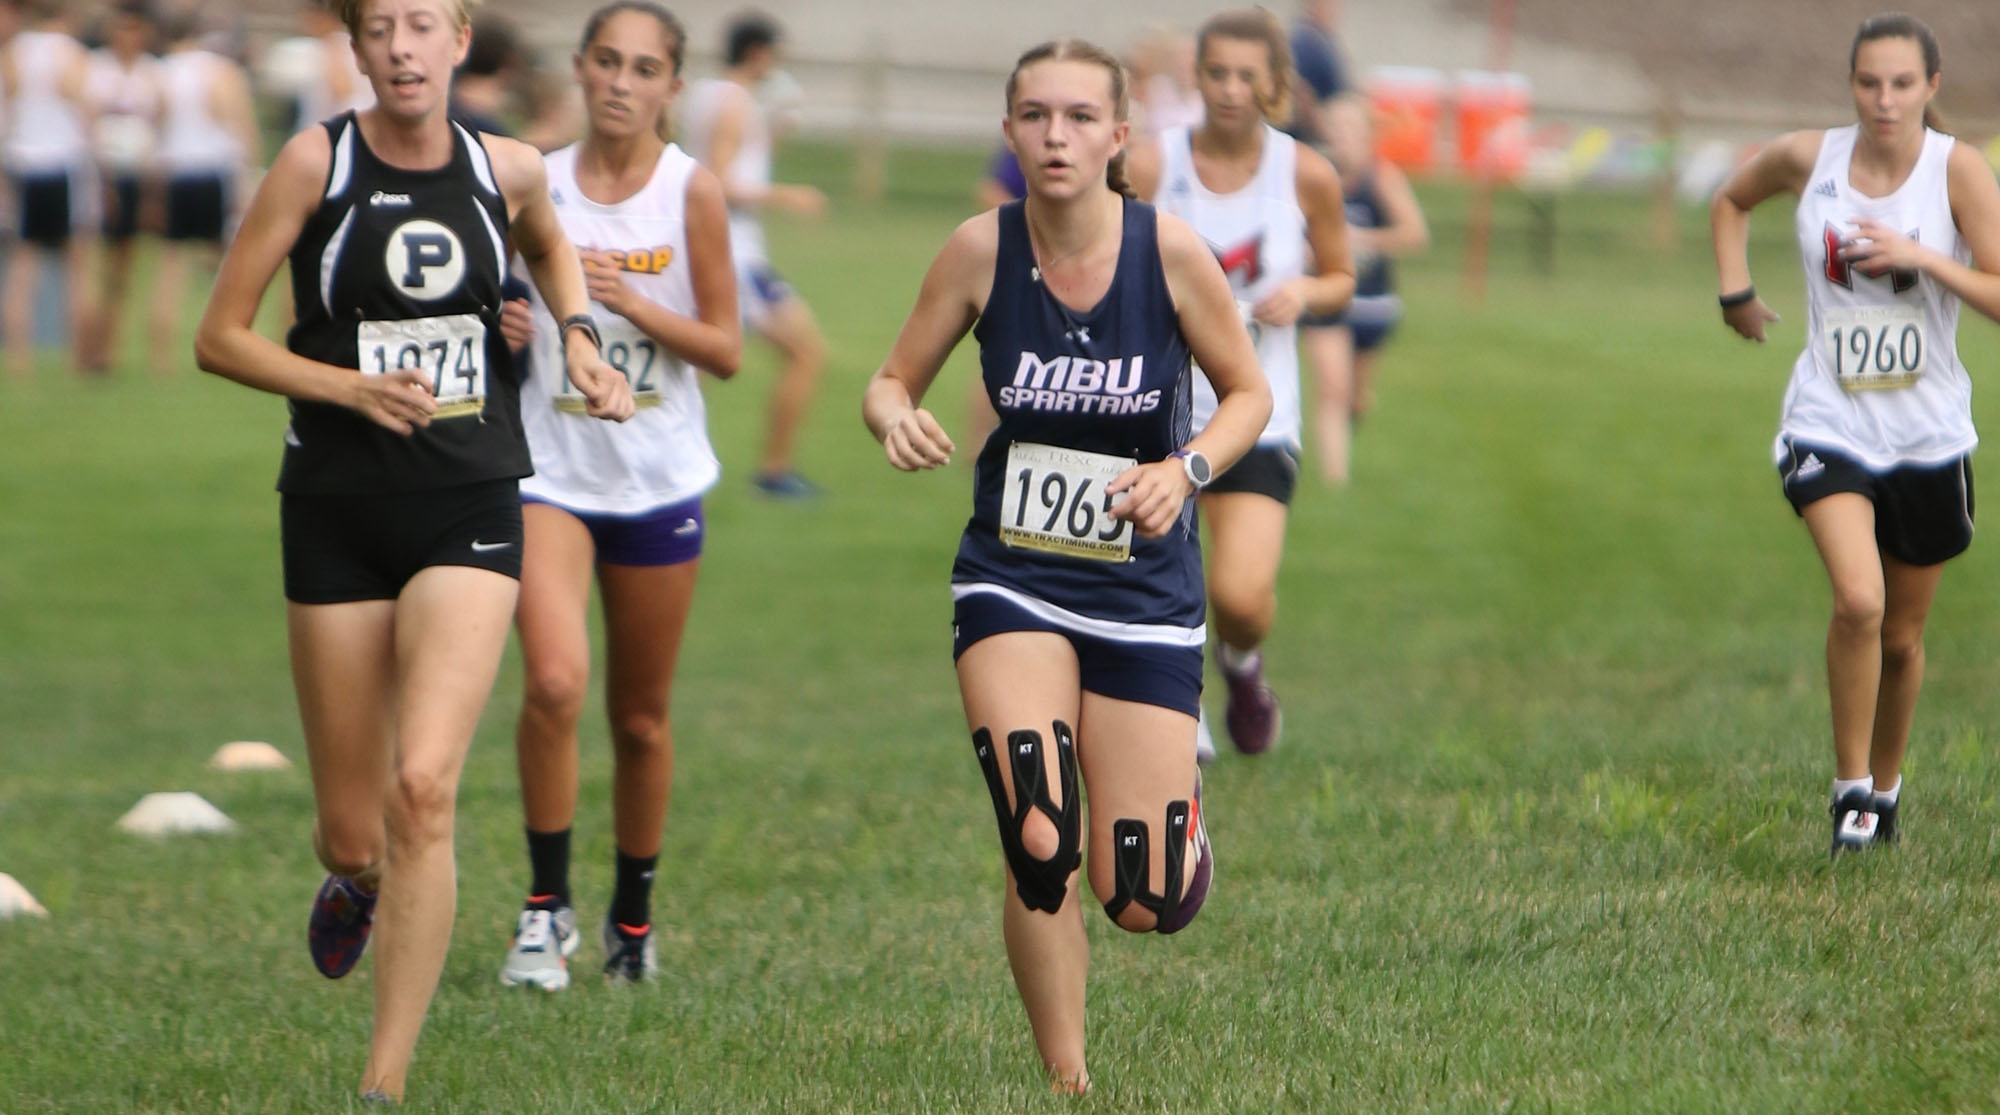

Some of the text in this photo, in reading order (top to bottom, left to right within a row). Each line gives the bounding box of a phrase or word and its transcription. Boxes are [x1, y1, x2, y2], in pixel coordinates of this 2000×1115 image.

[402, 232, 452, 288] P
[1833, 323, 1921, 374] 1960
[1013, 351, 1143, 393] MBU
[1000, 386, 1161, 414] SPARTANS
[1016, 467, 1127, 542] 1965
[1004, 527, 1124, 552] WWW.TRXCTIMING.COM
[1019, 743, 1033, 754] KT
[1174, 815, 1184, 825] KT
[1124, 836, 1138, 846] KT
